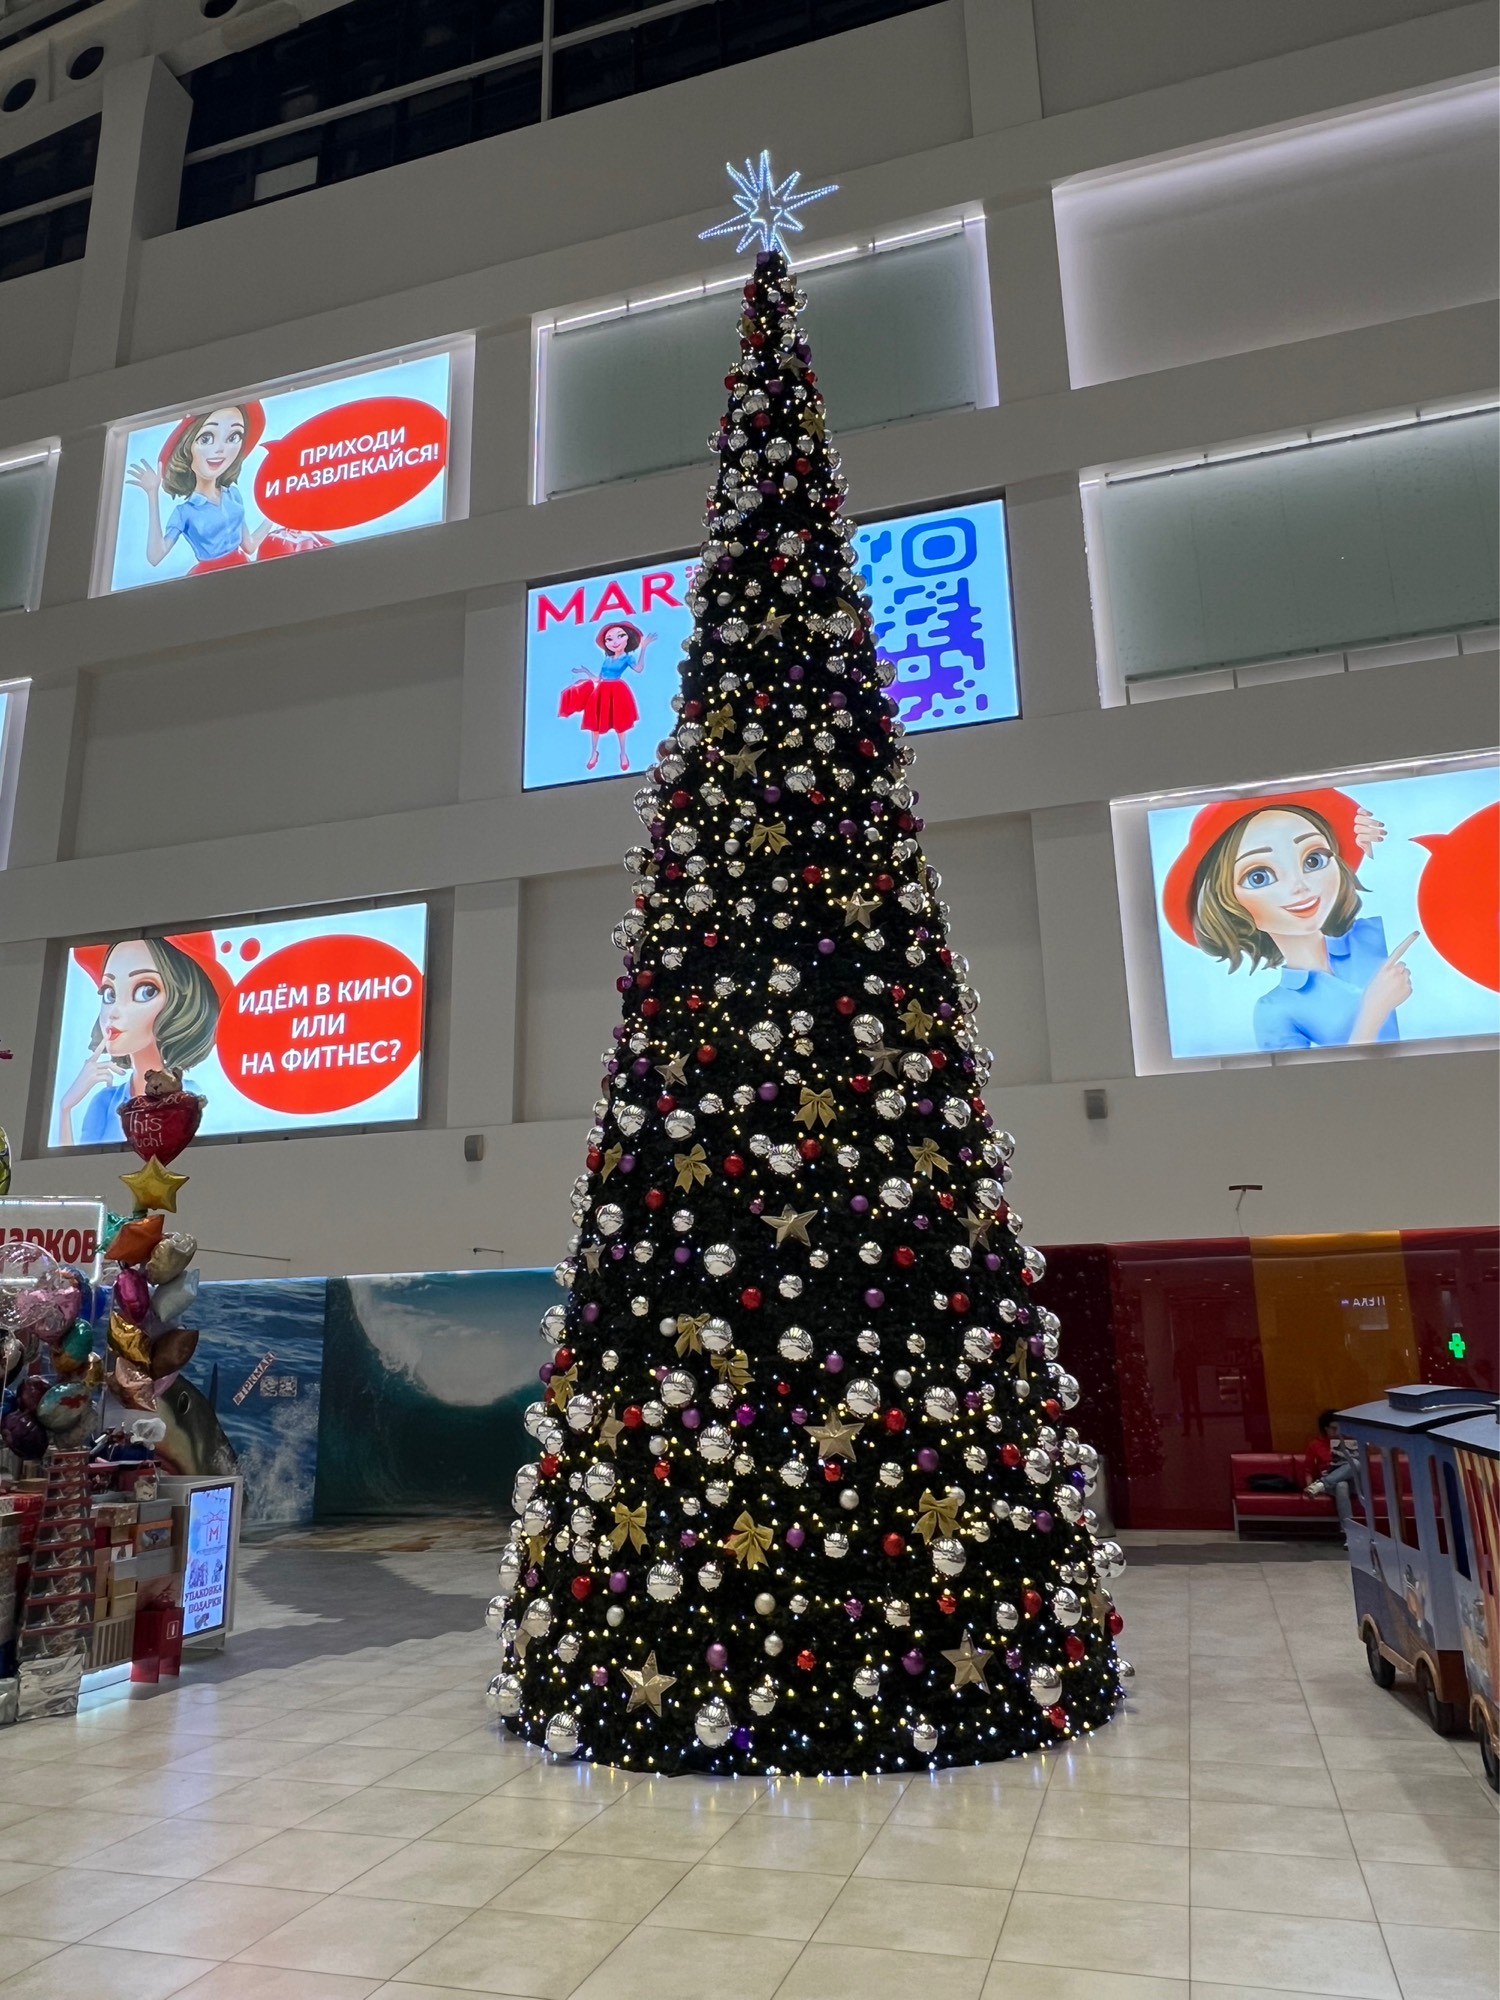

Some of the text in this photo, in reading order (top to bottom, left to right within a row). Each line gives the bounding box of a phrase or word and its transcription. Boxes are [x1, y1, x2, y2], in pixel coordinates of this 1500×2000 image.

[299, 427, 406, 467] ПРИХОДИ
[264, 443, 440, 498] И РАЗВЛЕКАЙСЯ!
[238, 974, 413, 1014] ИДЁМ В КИНО
[291, 1013, 346, 1039] ИЛИ
[240, 1039, 402, 1075] НА ФИТНЕС?
[125, 1109, 162, 1134] This
